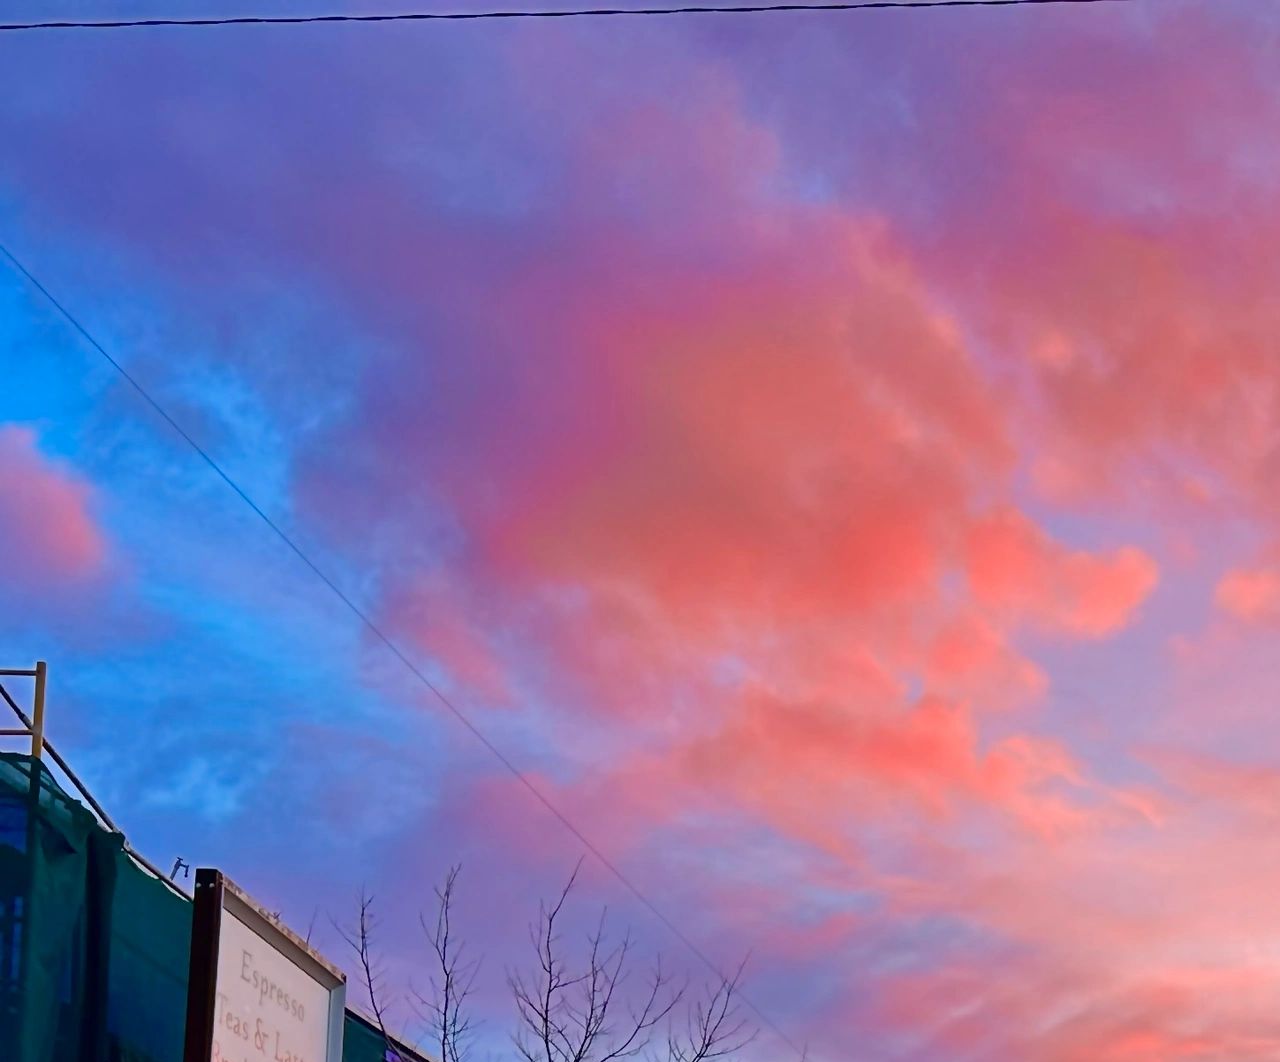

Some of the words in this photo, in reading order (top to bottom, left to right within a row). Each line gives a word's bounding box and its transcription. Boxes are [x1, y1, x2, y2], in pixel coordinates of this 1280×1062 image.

[240, 949, 305, 1023] Espresso
[217, 992, 249, 1041] Teas
[254, 1017, 269, 1055] &
